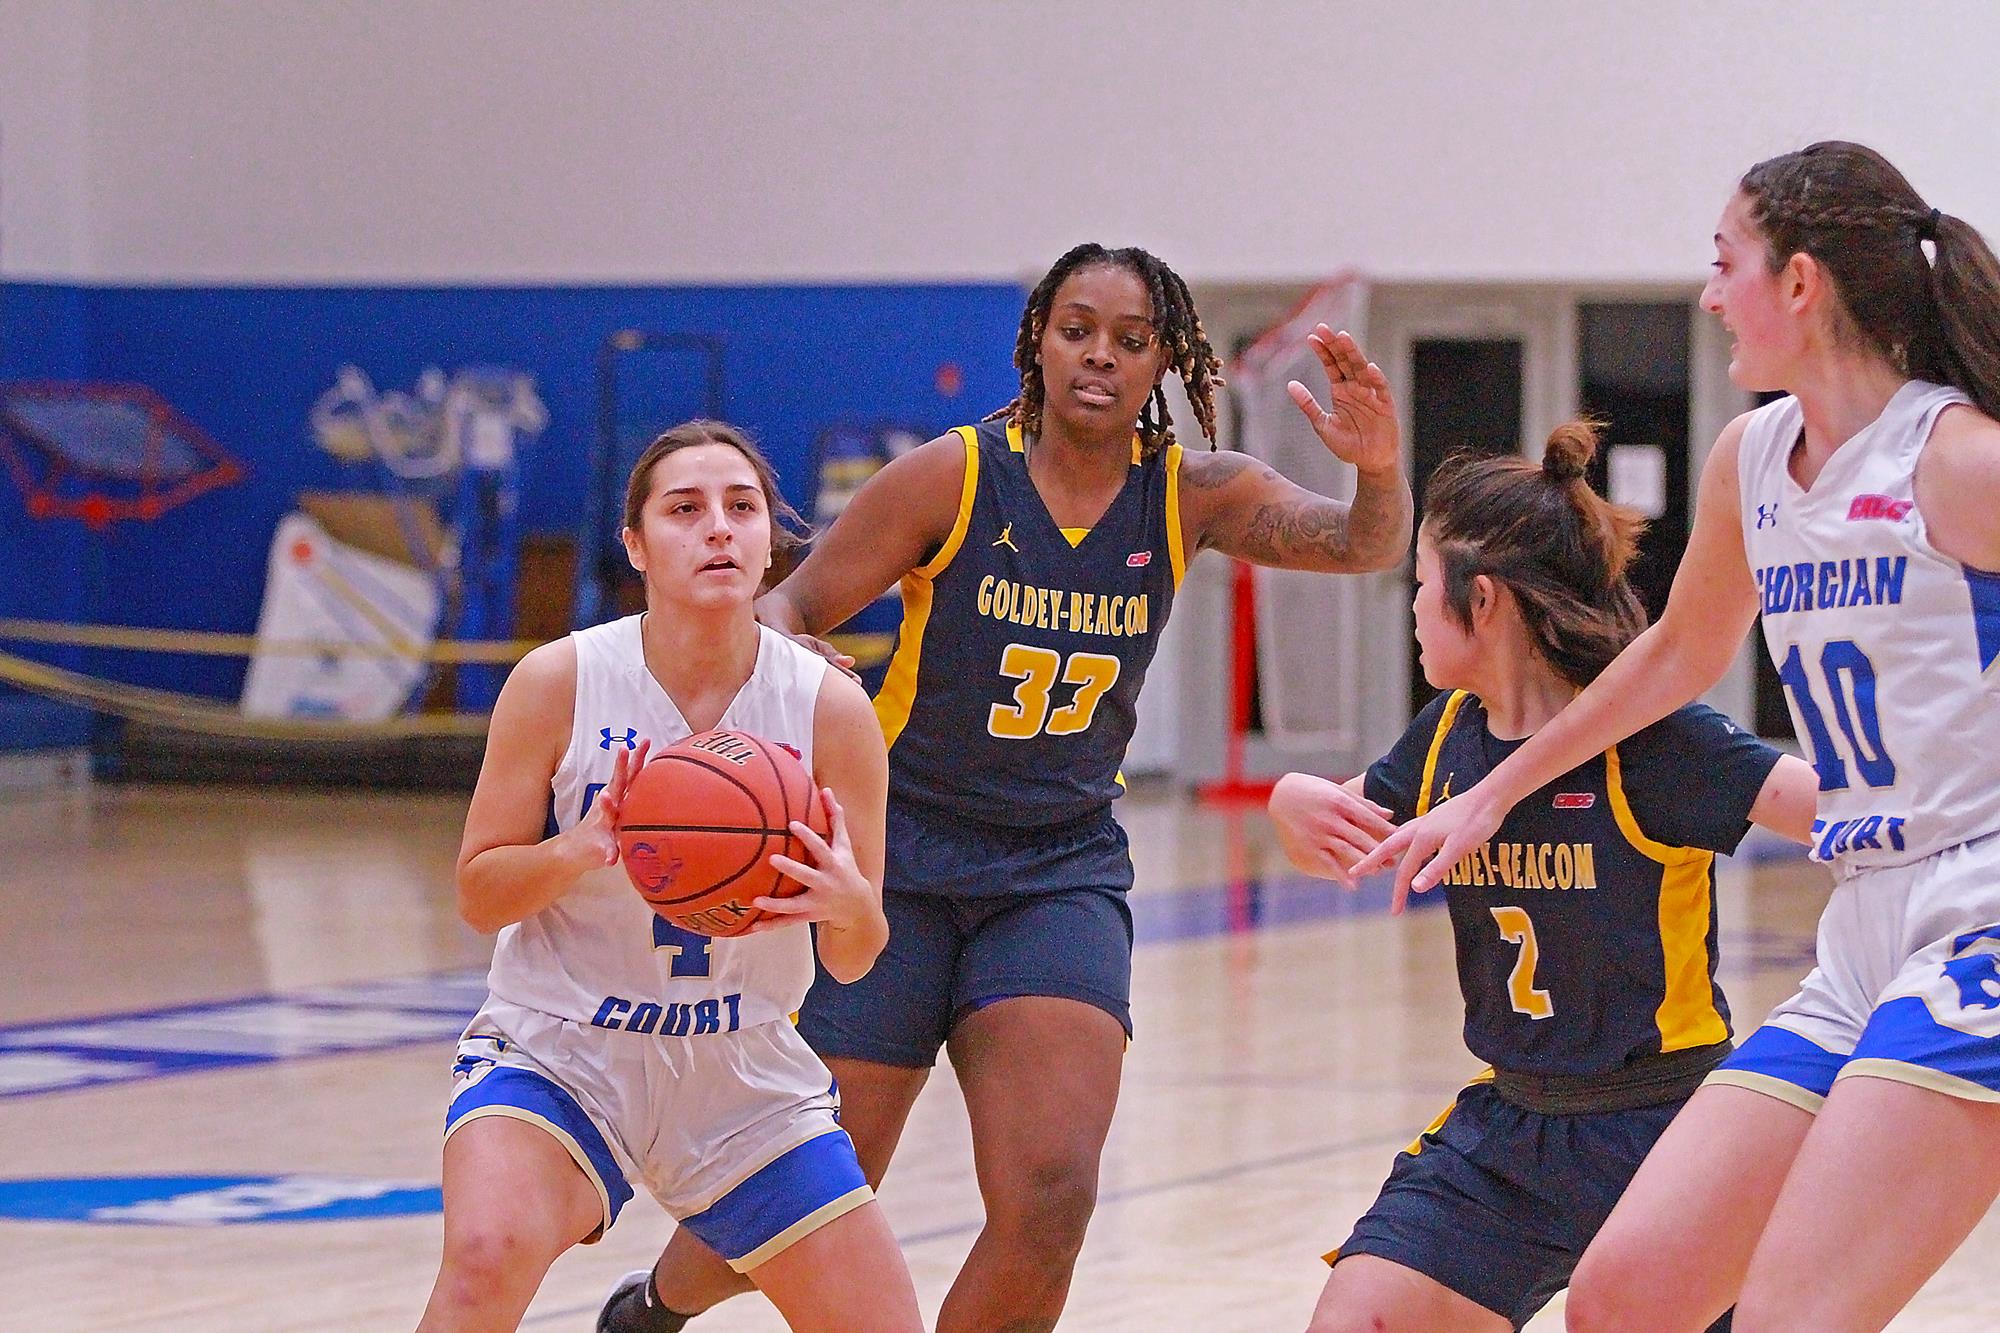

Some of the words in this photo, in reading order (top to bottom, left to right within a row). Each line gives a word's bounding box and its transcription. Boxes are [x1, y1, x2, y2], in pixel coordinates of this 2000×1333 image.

[977, 574, 1148, 637] GOLDEY-BEACON
[987, 643, 1120, 739] 33
[1780, 639, 1896, 791] 10
[691, 731, 756, 766] THE
[1443, 842, 1598, 890] LDEY-BEACON
[1489, 906, 1554, 1020] 2
[591, 993, 741, 1037] COURT
